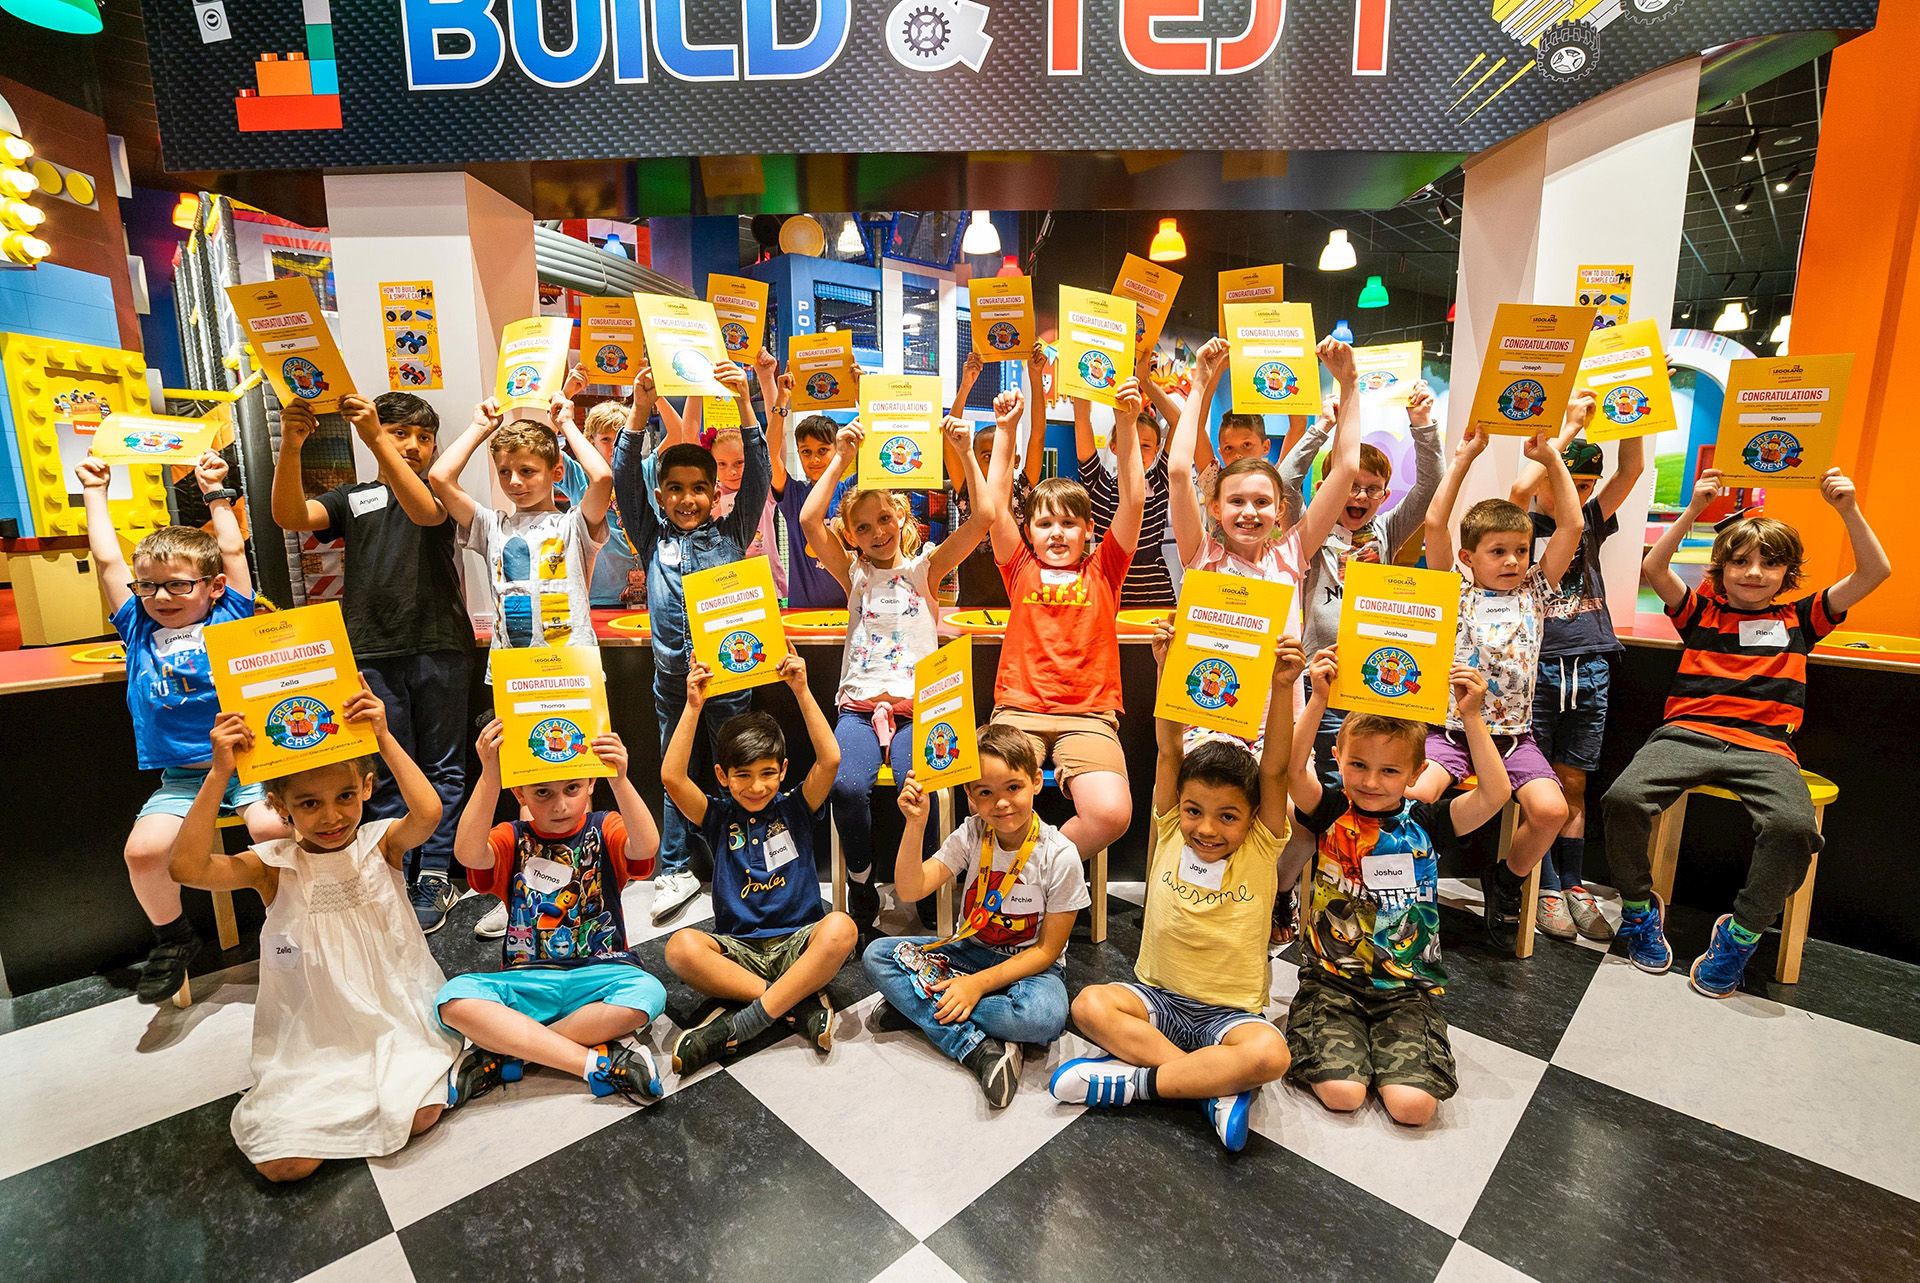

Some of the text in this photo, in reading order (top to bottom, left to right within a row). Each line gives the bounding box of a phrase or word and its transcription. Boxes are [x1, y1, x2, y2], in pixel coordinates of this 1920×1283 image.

[1126, 280, 1164, 300] CONGRATULATIONS
[1228, 288, 1272, 299] CONGRATULATIONS
[716, 296, 757, 308] CONGRATULATIONS
[251, 314, 308, 330] CONGRATULATIONS
[1072, 314, 1123, 332] CONGRATULATIONS
[1241, 329, 1299, 337] CONGRATULATIONS
[1504, 338, 1569, 350] CONGRATULATIONS
[799, 348, 841, 357] CONGRATULATIONS
[1584, 349, 1645, 368] CONGRATULATIONS
[1506, 382, 1541, 397] CREATIVE
[1742, 390, 1823, 401] CONGRATULATIONS
[1606, 390, 1642, 406] CREATIVE
[872, 403, 928, 411] CONGRATULATIONS
[1506, 408, 1531, 418] CREW
[1614, 411, 1640, 422] CREW
[1751, 433, 1795, 449] CREATIVE
[1753, 460, 1784, 470] CREW
[359, 497, 379, 506] Aryan
[1222, 588, 1249, 596] LEGOLAND
[700, 589, 759, 611] CONGRATULATIONS
[1360, 599, 1436, 619] CONGRATULATIONS
[1192, 608, 1264, 631] CONGRATULATIONS
[259, 624, 293, 635] LEGOLAND
[1384, 630, 1408, 638] Joshua
[164, 632, 193, 644] Ezekiel
[722, 633, 756, 652] CREATIVE
[235, 643, 326, 672] CONGRATULATIONS
[1370, 649, 1414, 671] CREATIVE
[730, 660, 754, 670] CREW
[1194, 662, 1234, 683] CREATIVE
[280, 679, 300, 688] Zella
[512, 678, 585, 690] CONGRATULATIONS
[921, 674, 960, 700] CONGRATULATIONS
[1373, 681, 1403, 694] CREW
[1195, 693, 1222, 706] CREW
[271, 699, 324, 724] CREATIVE
[535, 721, 577, 739] CREATIVE
[286, 732, 321, 747] CREW
[543, 749, 572, 760] CREW
[1190, 864, 1207, 874] Jaye
[533, 869, 560, 884] Thomas
[1162, 871, 1254, 905] awesome
